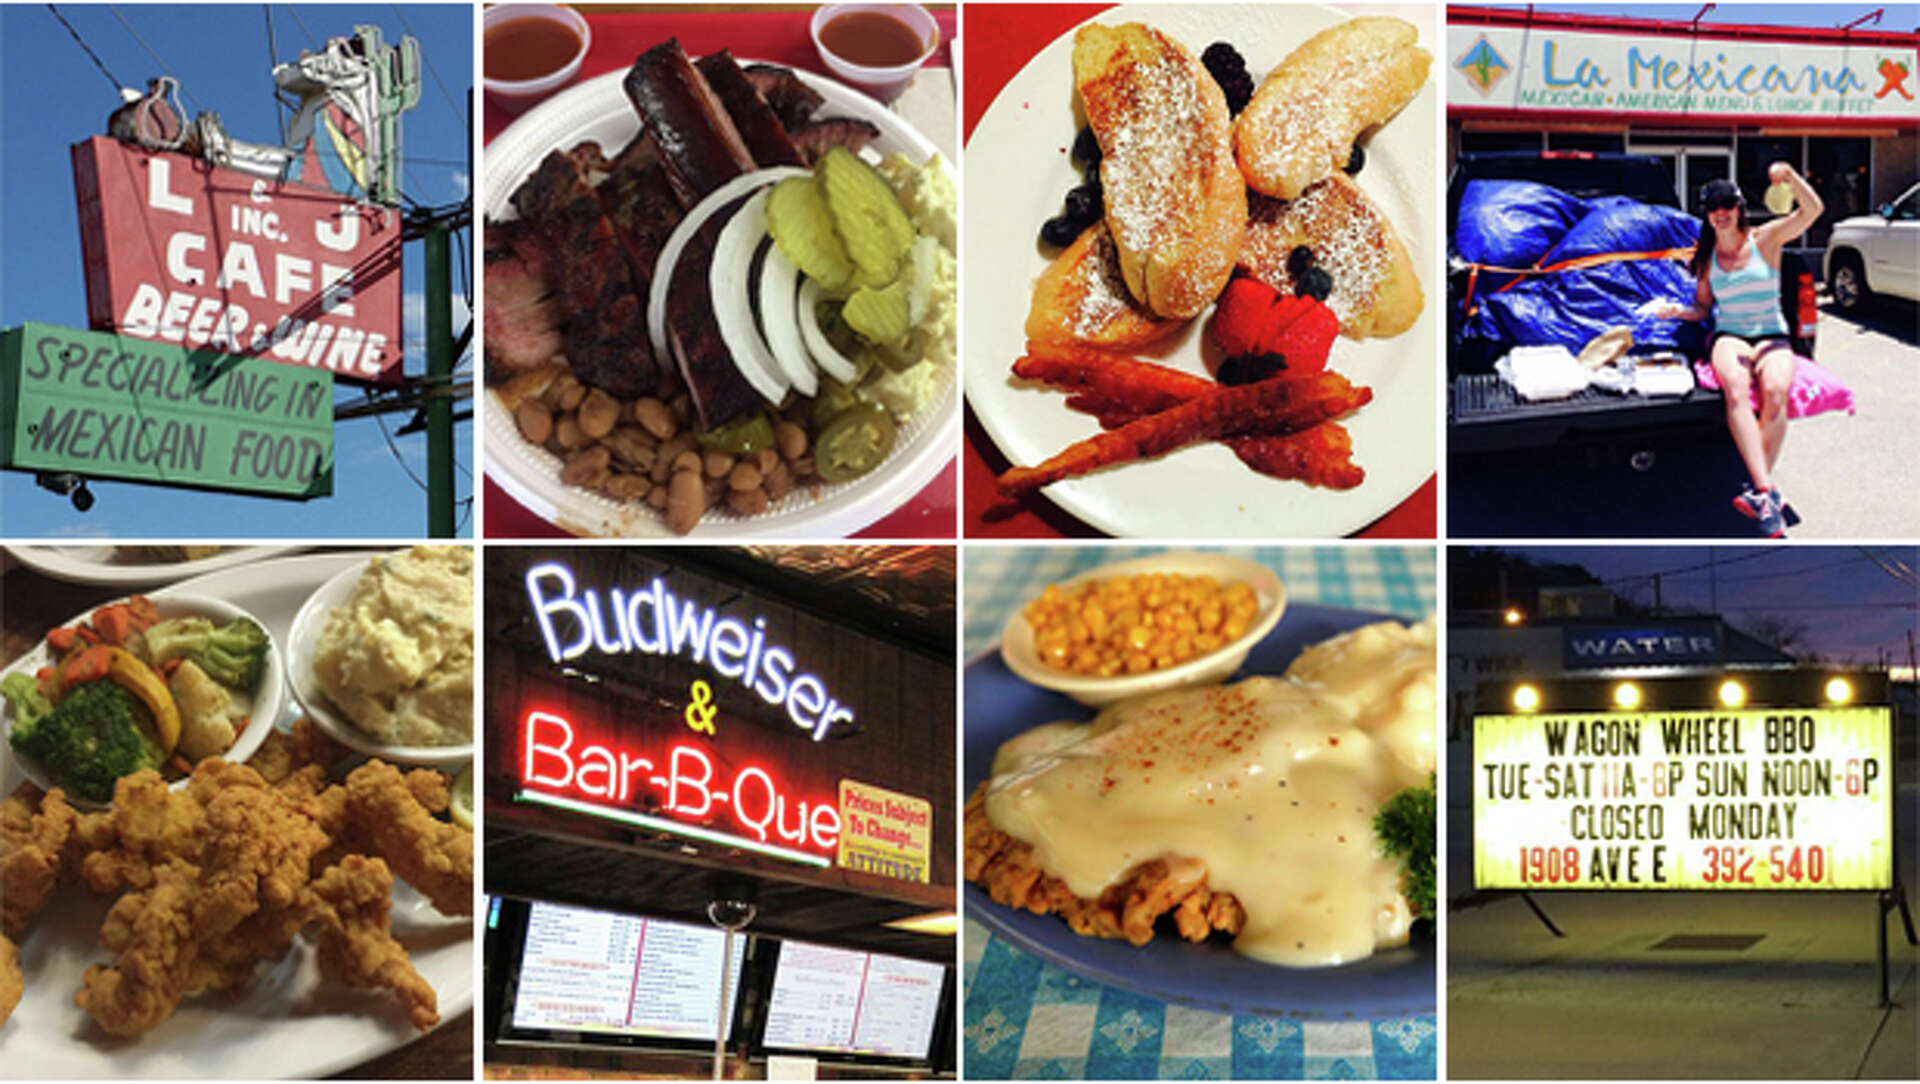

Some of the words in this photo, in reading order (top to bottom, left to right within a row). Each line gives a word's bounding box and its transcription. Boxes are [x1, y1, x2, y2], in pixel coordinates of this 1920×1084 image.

[1543, 39, 1609, 88] La
[1627, 45, 1867, 95] Mexicana
[1520, 89, 1605, 105] MEXICAN
[1615, 91, 1698, 111] AMERICAN
[148, 158, 193, 215] L
[250, 180, 272, 203] &
[315, 204, 360, 251] J
[231, 205, 288, 243] INC.
[167, 231, 355, 317] CAFE
[123, 284, 249, 352] BEER
[271, 314, 386, 375] WINE
[27, 337, 278, 413] SPECIALIZING
[285, 379, 326, 419] IN
[30, 405, 206, 472] MEXICAN
[230, 429, 323, 483] FOOD
[526, 562, 855, 741] Budweiser
[1571, 635, 1716, 656] WATER
[685, 679, 717, 736] &
[1544, 719, 1641, 756] WAGON
[1661, 717, 1746, 755] WHEEL
[526, 711, 841, 847] Bar-B-Que
[1696, 760, 1747, 797] SUN
[1762, 758, 1879, 796] NOON-6P
[1571, 804, 1664, 840] CLOSED
[1689, 802, 1797, 840] MONDAY
[1520, 846, 1580, 883] 1908
[1589, 845, 1640, 883] AVE
[1653, 845, 1667, 882] E
